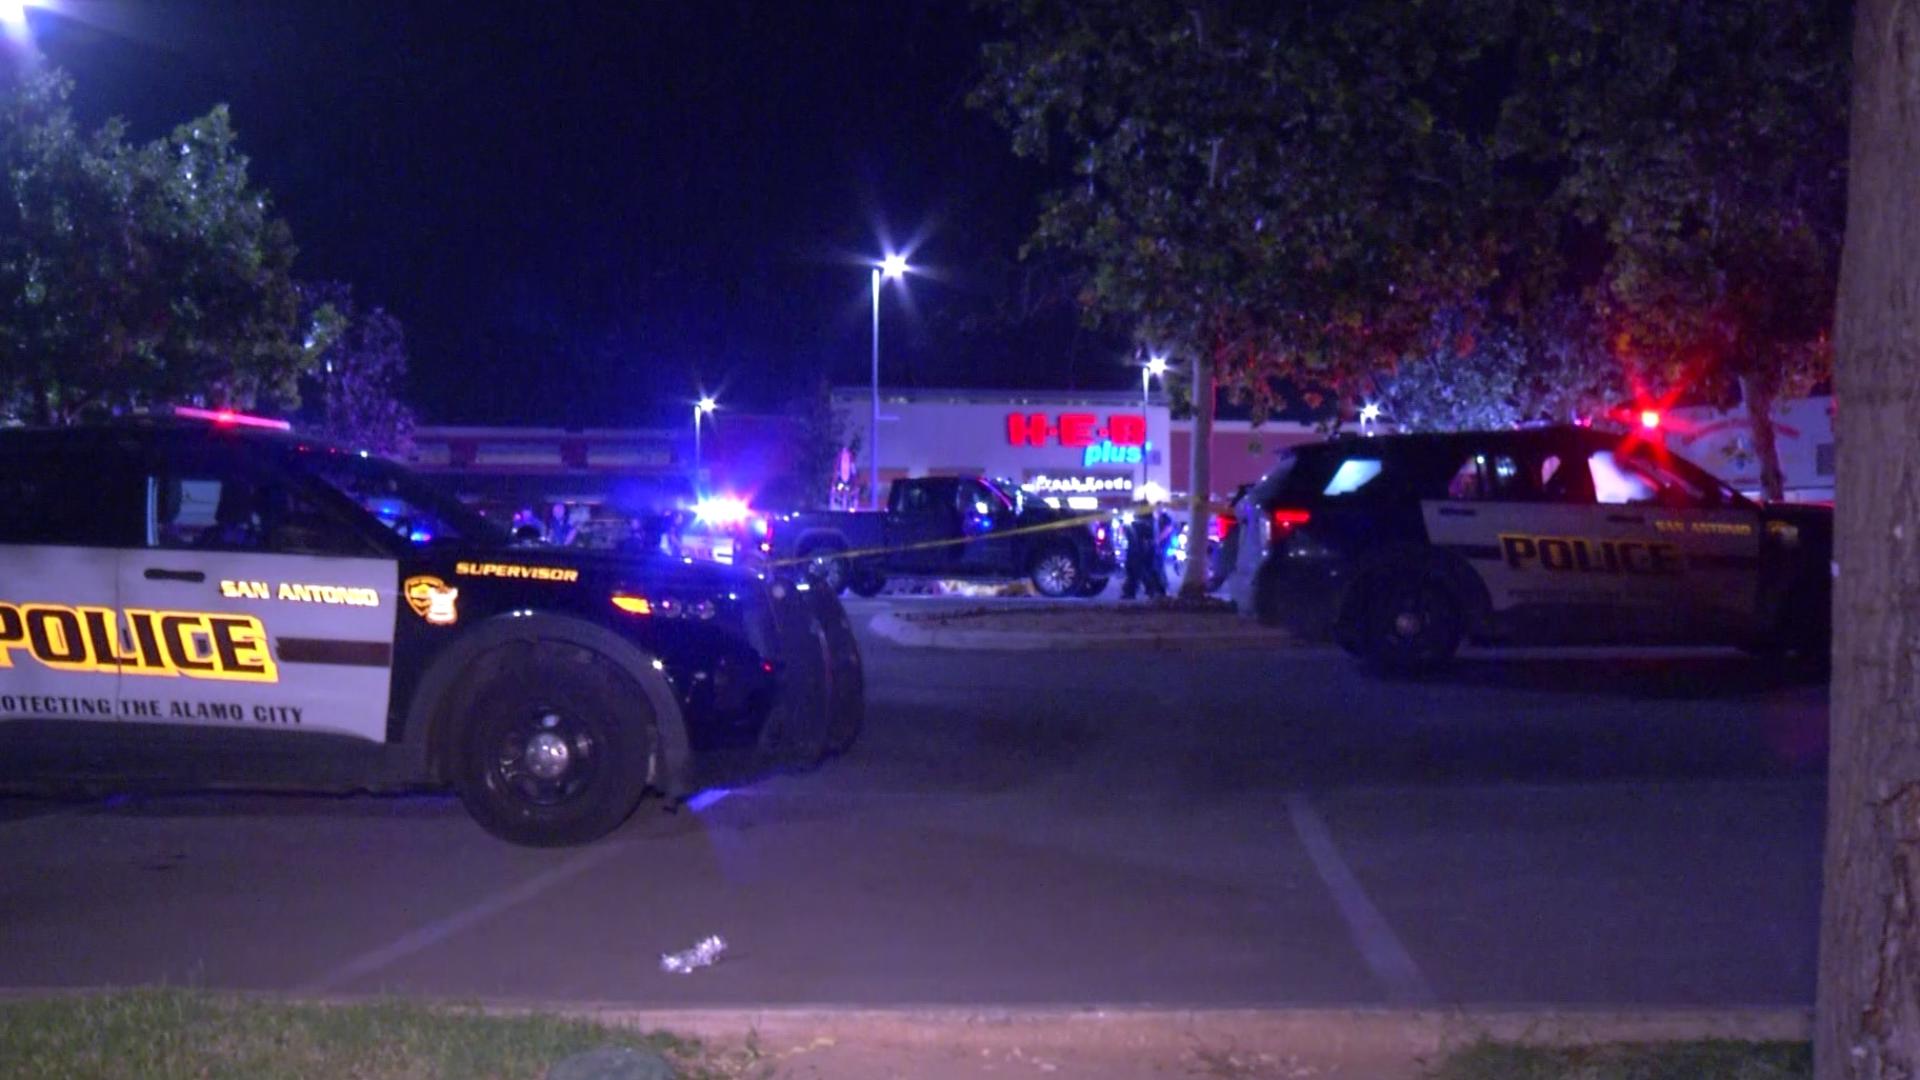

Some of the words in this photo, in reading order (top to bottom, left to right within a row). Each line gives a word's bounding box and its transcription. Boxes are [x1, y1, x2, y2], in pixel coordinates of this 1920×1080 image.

[1655, 519, 1684, 532] SAN
[1691, 520, 1751, 534] ANTONIO
[1498, 532, 1680, 575] POLICE
[456, 562, 578, 582] SUPERVISOR
[220, 580, 269, 600] SAN
[278, 583, 379, 607] ANTONIO
[0, 695, 111, 715] OTECTING
[122, 699, 162, 717] THE
[170, 702, 243, 721] ALAMO
[254, 706, 303, 724] CITY
